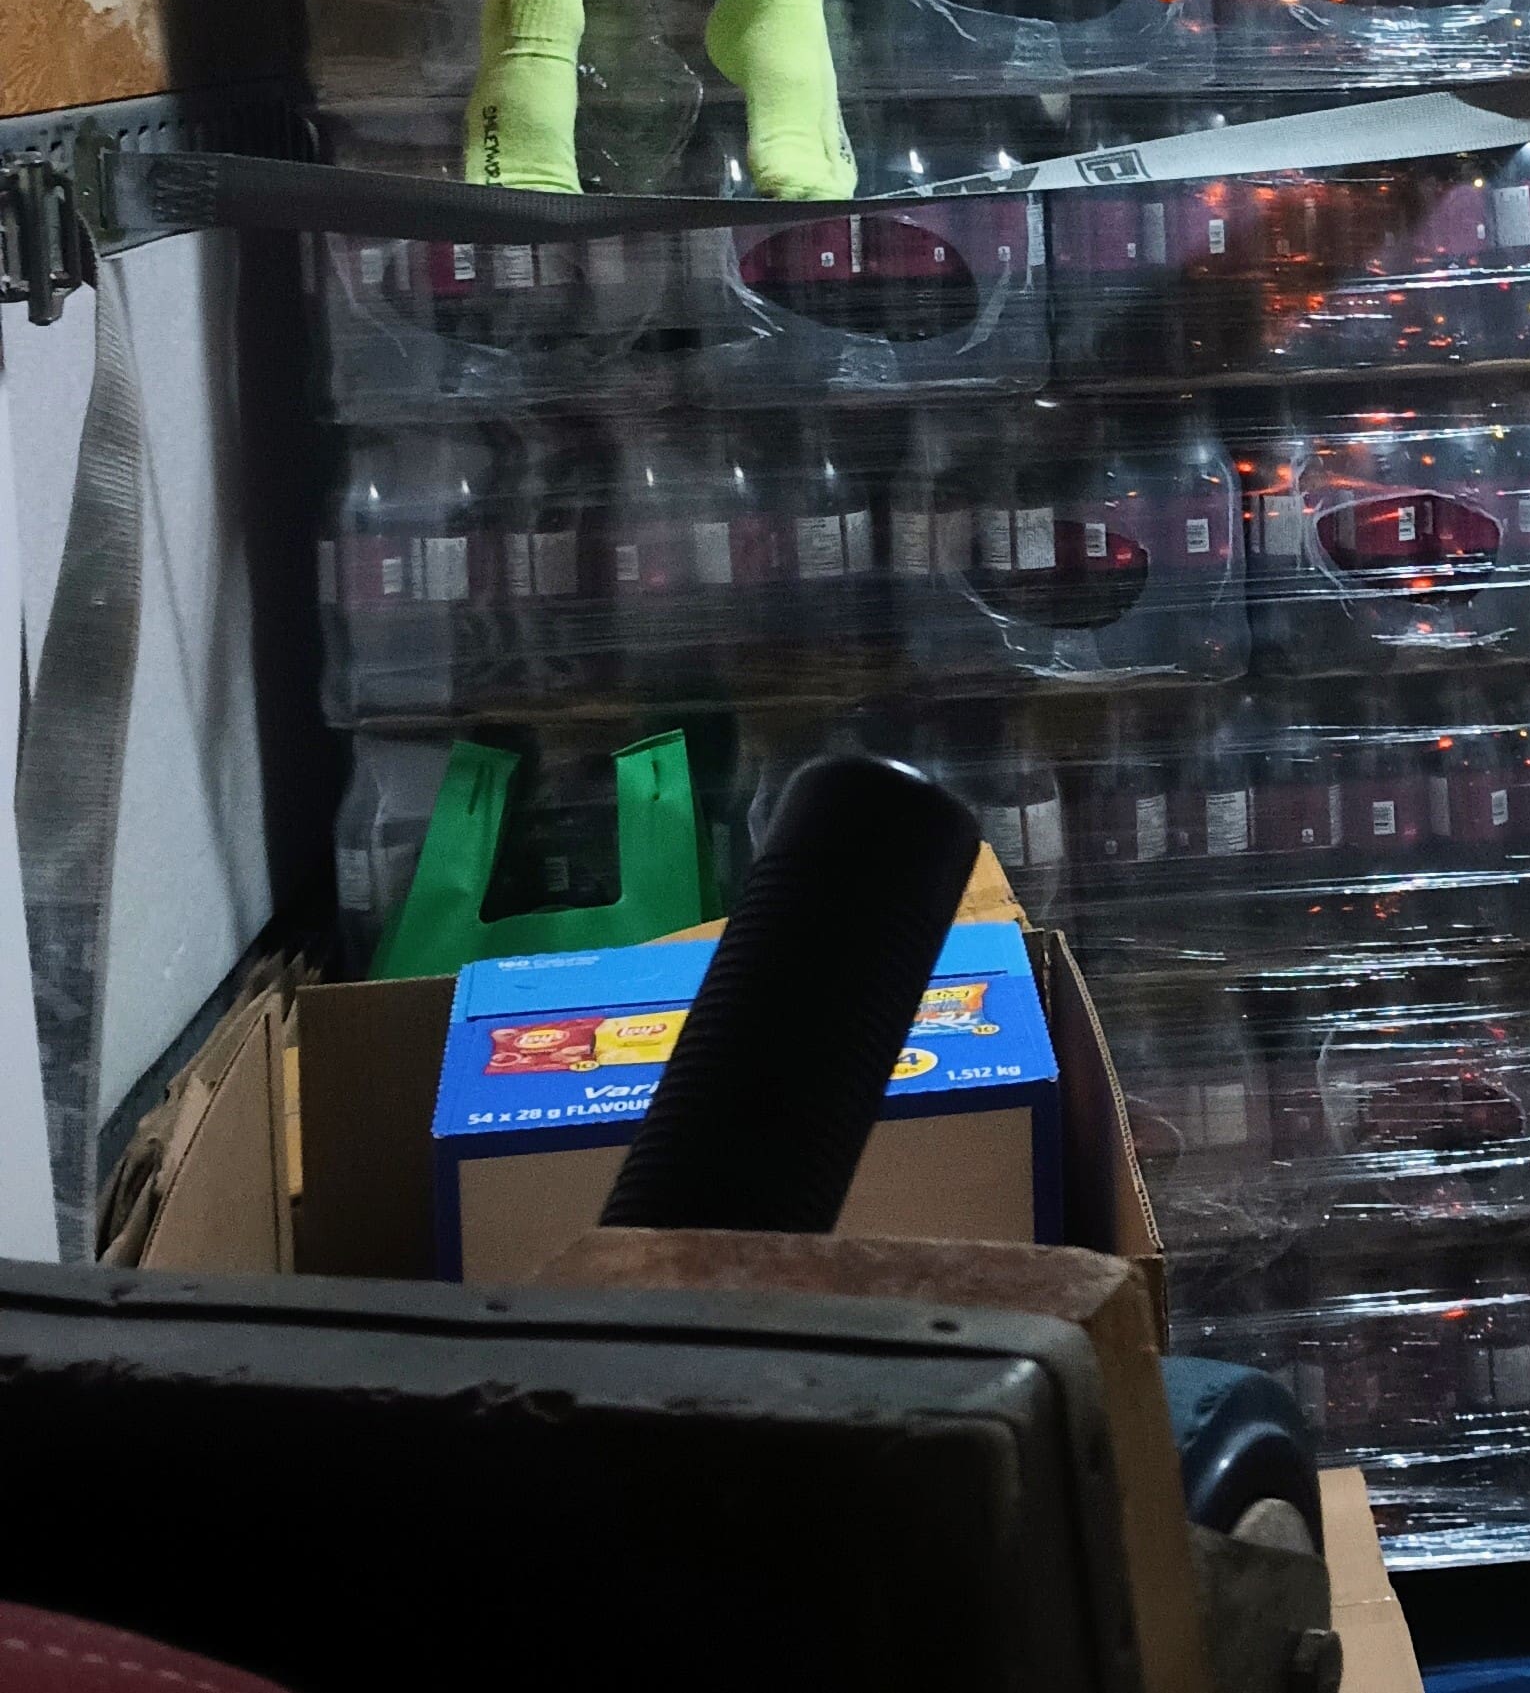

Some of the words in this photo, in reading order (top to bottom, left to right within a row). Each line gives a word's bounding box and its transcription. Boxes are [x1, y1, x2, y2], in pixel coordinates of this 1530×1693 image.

[947, 1066, 992, 1081] 1.512
[997, 1064, 1021, 1077] kg
[467, 1112, 493, 1125] 54
[498, 1112, 511, 1122] x
[515, 1108, 537, 1121] 28
[548, 1107, 561, 1120] g
